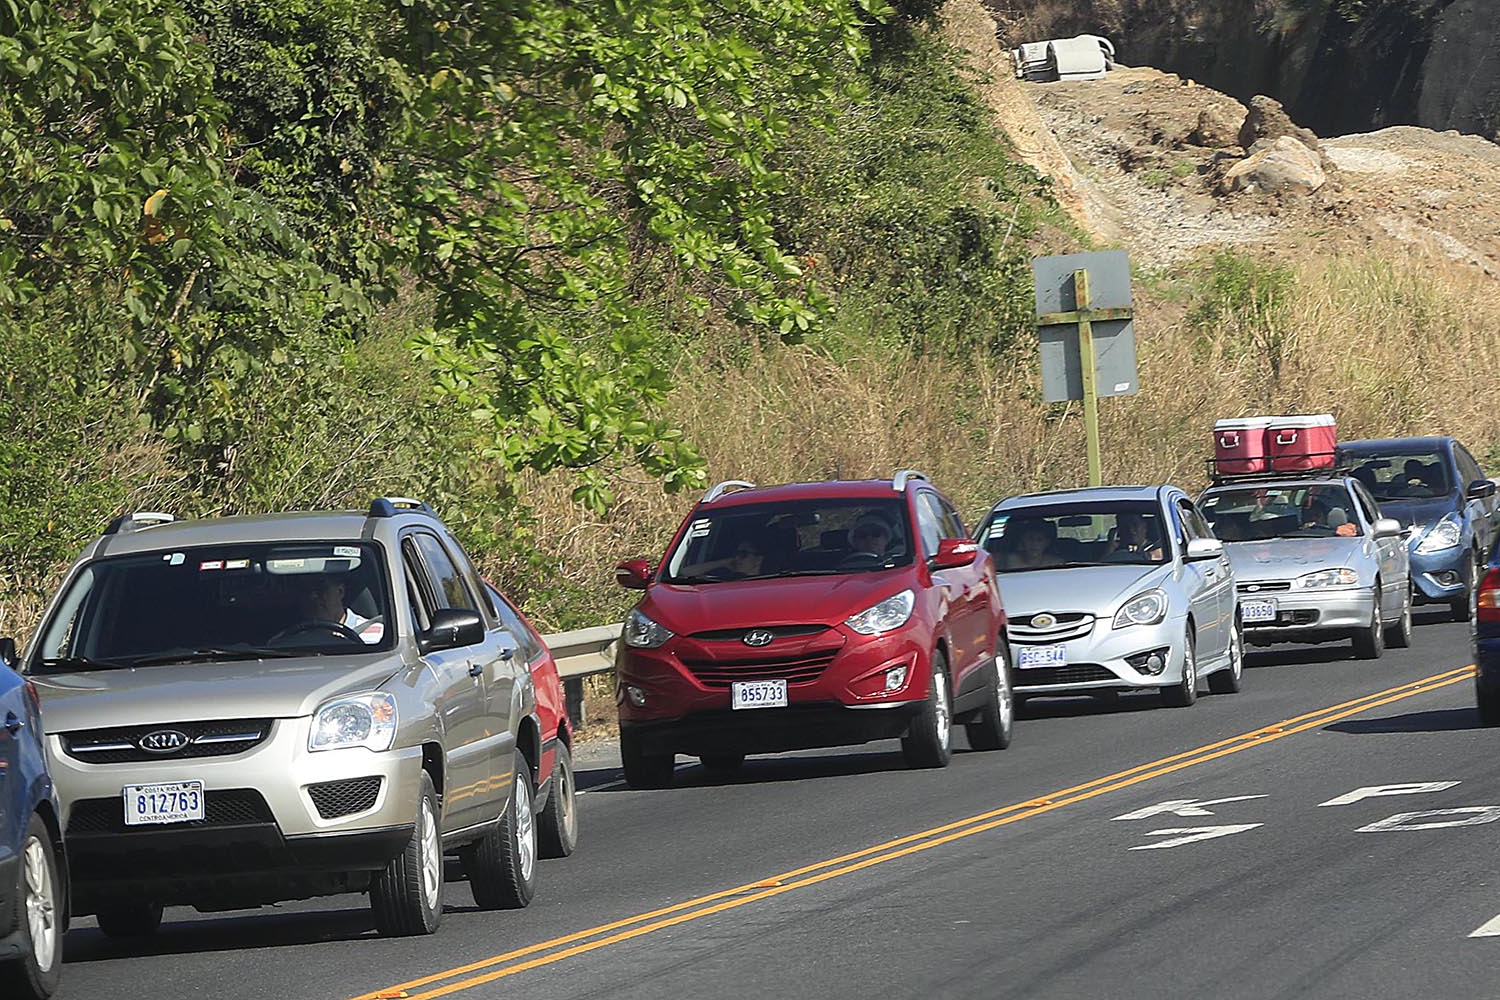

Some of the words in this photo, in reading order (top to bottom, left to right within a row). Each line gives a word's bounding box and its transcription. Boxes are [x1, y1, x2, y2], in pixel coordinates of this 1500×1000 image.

[741, 687, 783, 702] 855733
[148, 734, 181, 749] KIA
[137, 791, 199, 815] 812763
